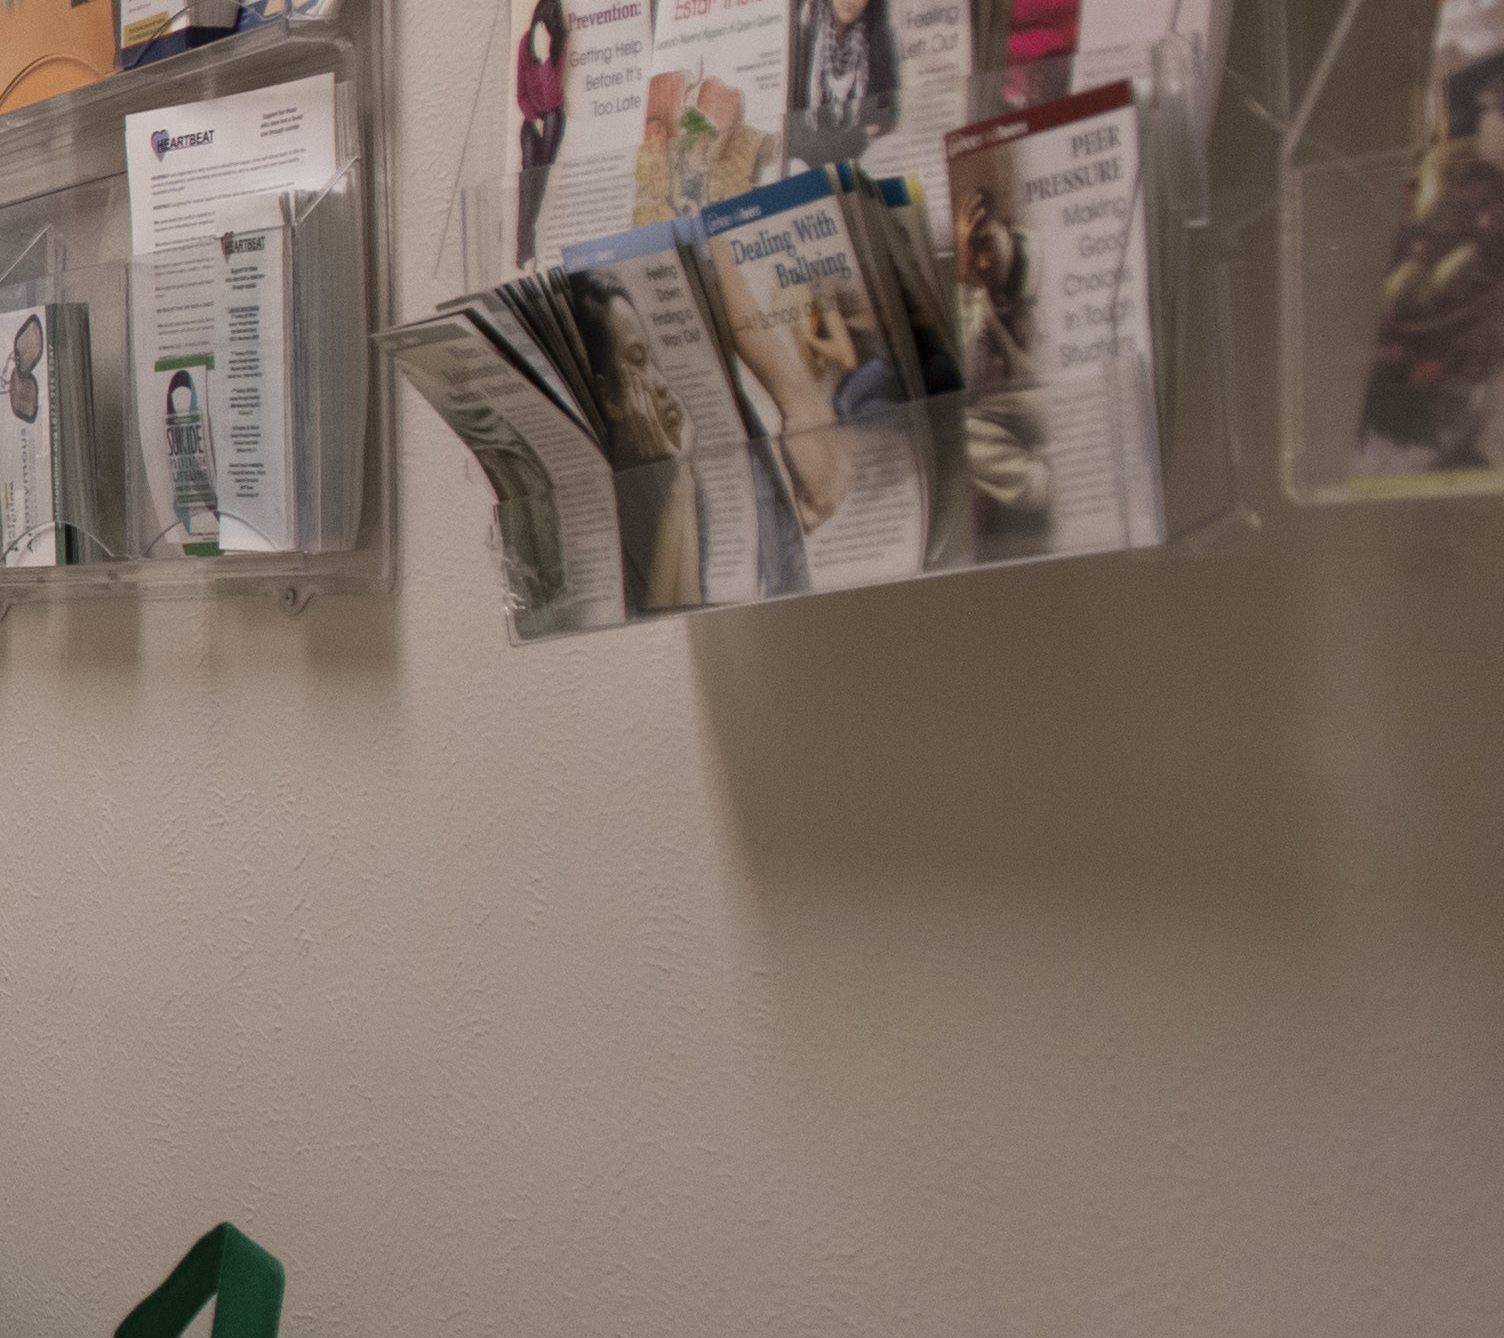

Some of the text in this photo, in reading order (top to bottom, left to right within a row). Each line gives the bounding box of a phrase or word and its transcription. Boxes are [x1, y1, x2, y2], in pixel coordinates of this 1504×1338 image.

[568, 0, 642, 32] Prevention:
[905, 4, 960, 29] Feeling
[570, 38, 643, 68] Getting Help
[902, 30, 959, 59] Left Out
[586, 64, 643, 93] Before It's
[591, 93, 642, 119] Too Late
[157, 129, 215, 154] HEARTBEAT
[1069, 124, 1122, 158] PEER
[1024, 156, 1122, 205] PRESSURE
[225, 235, 265, 255] HEARTBEAT
[730, 228, 798, 266] Dealing
[792, 209, 838, 244] With
[774, 251, 852, 290] Bullying
[166, 424, 204, 457] SUICIDE
